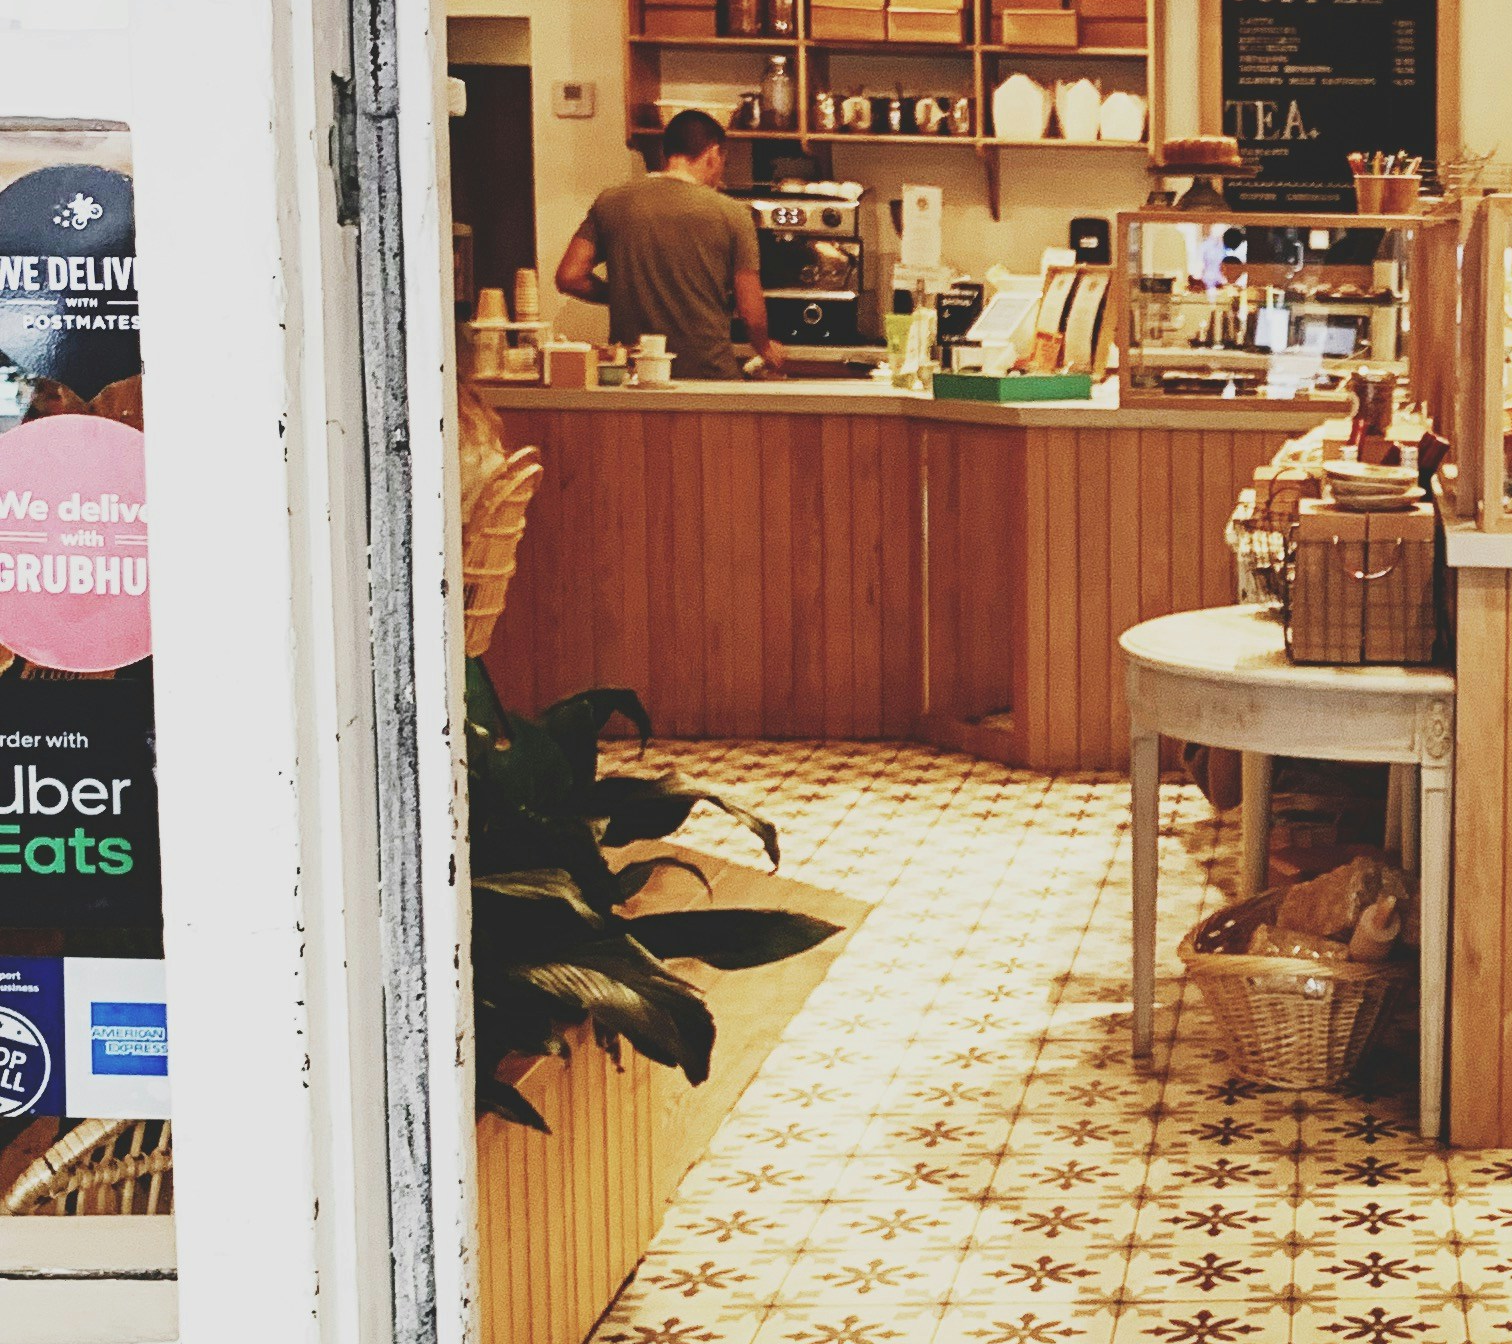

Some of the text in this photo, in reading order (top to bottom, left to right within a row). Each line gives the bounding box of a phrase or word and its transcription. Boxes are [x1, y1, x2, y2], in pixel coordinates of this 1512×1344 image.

[1225, 99, 1321, 141] TEA.
[65, 297, 98, 308] WITH
[22, 314, 140, 331] POSTMATES
[0, 490, 49, 521] We
[60, 530, 105, 547] with
[45, 731, 89, 748] with
[0, 824, 134, 875] Eats
[92, 1028, 164, 1038] AMERICAN
[108, 1043, 168, 1054] EXPRESS
